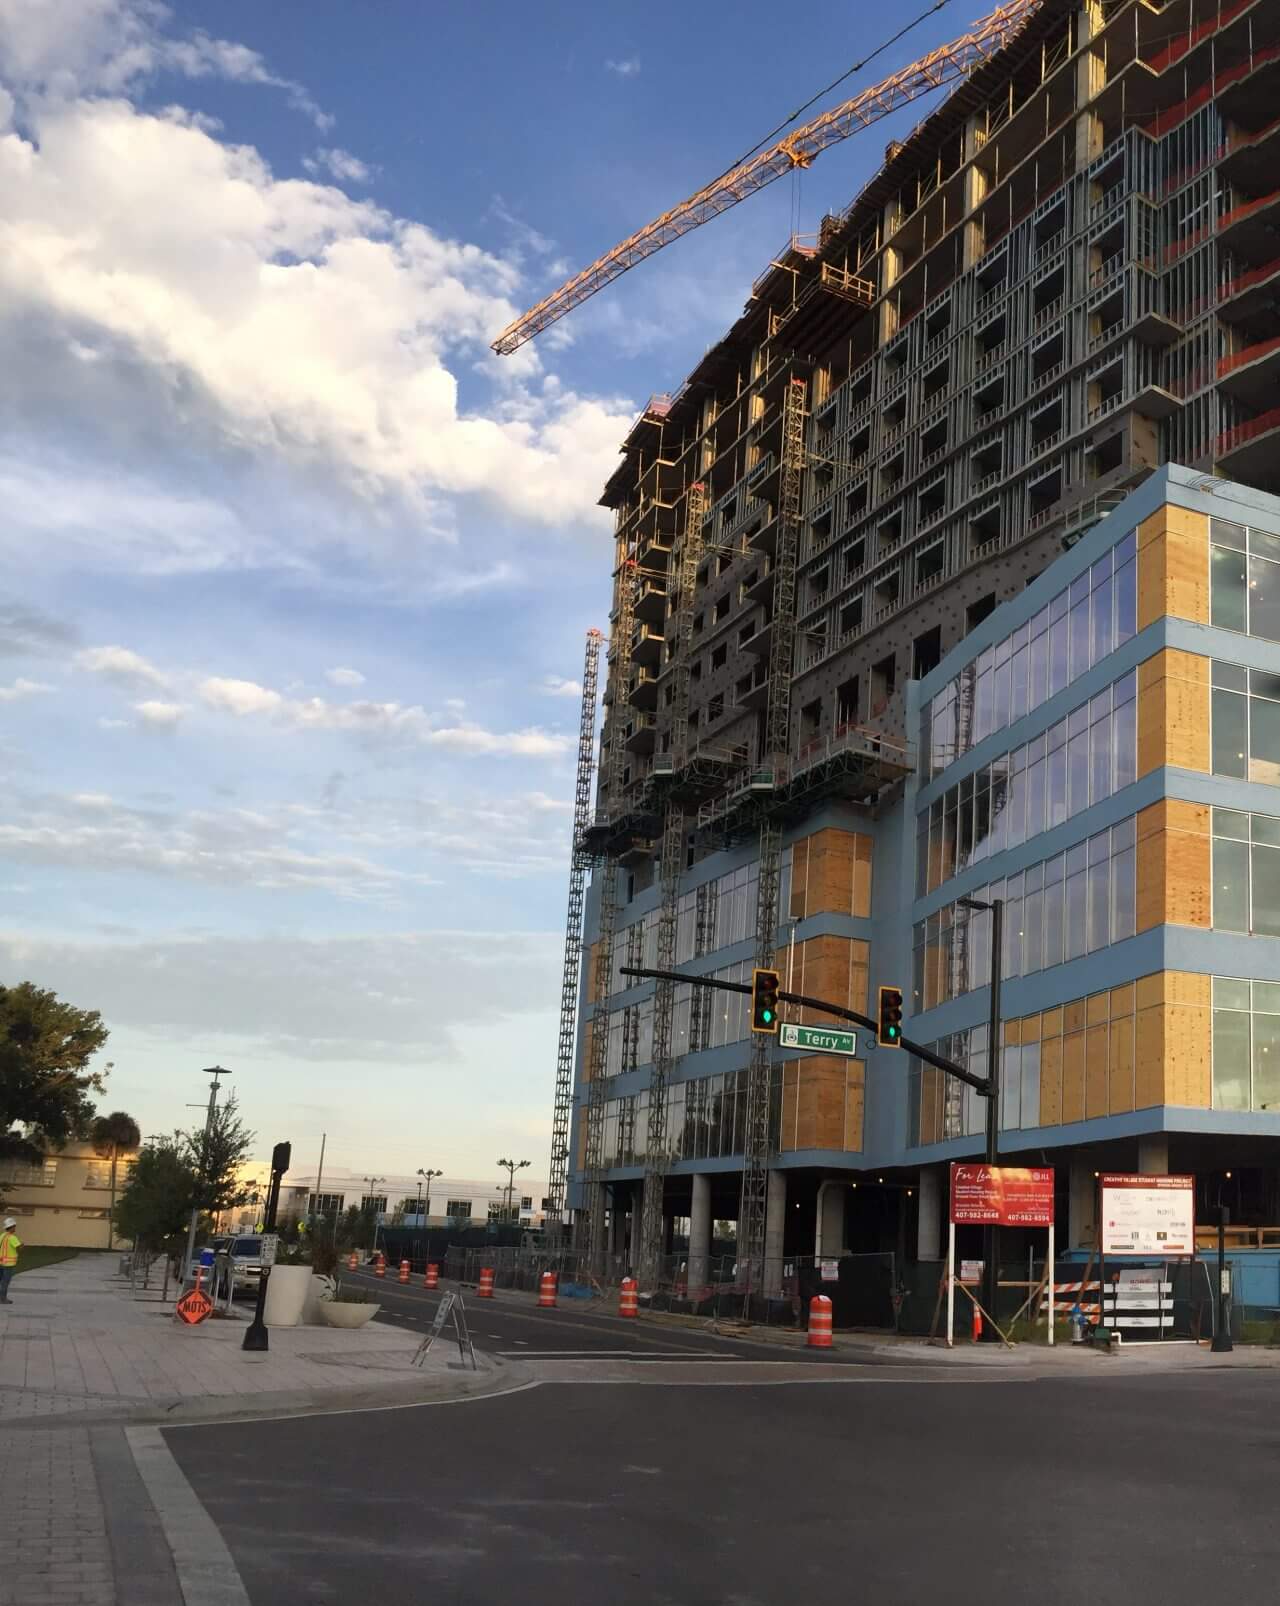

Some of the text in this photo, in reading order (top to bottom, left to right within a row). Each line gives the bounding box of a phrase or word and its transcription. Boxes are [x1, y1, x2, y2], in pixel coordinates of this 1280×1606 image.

[805, 1032, 838, 1049] Terry
[955, 1167, 974, 1181] For
[182, 1301, 207, 1313] SLOW
